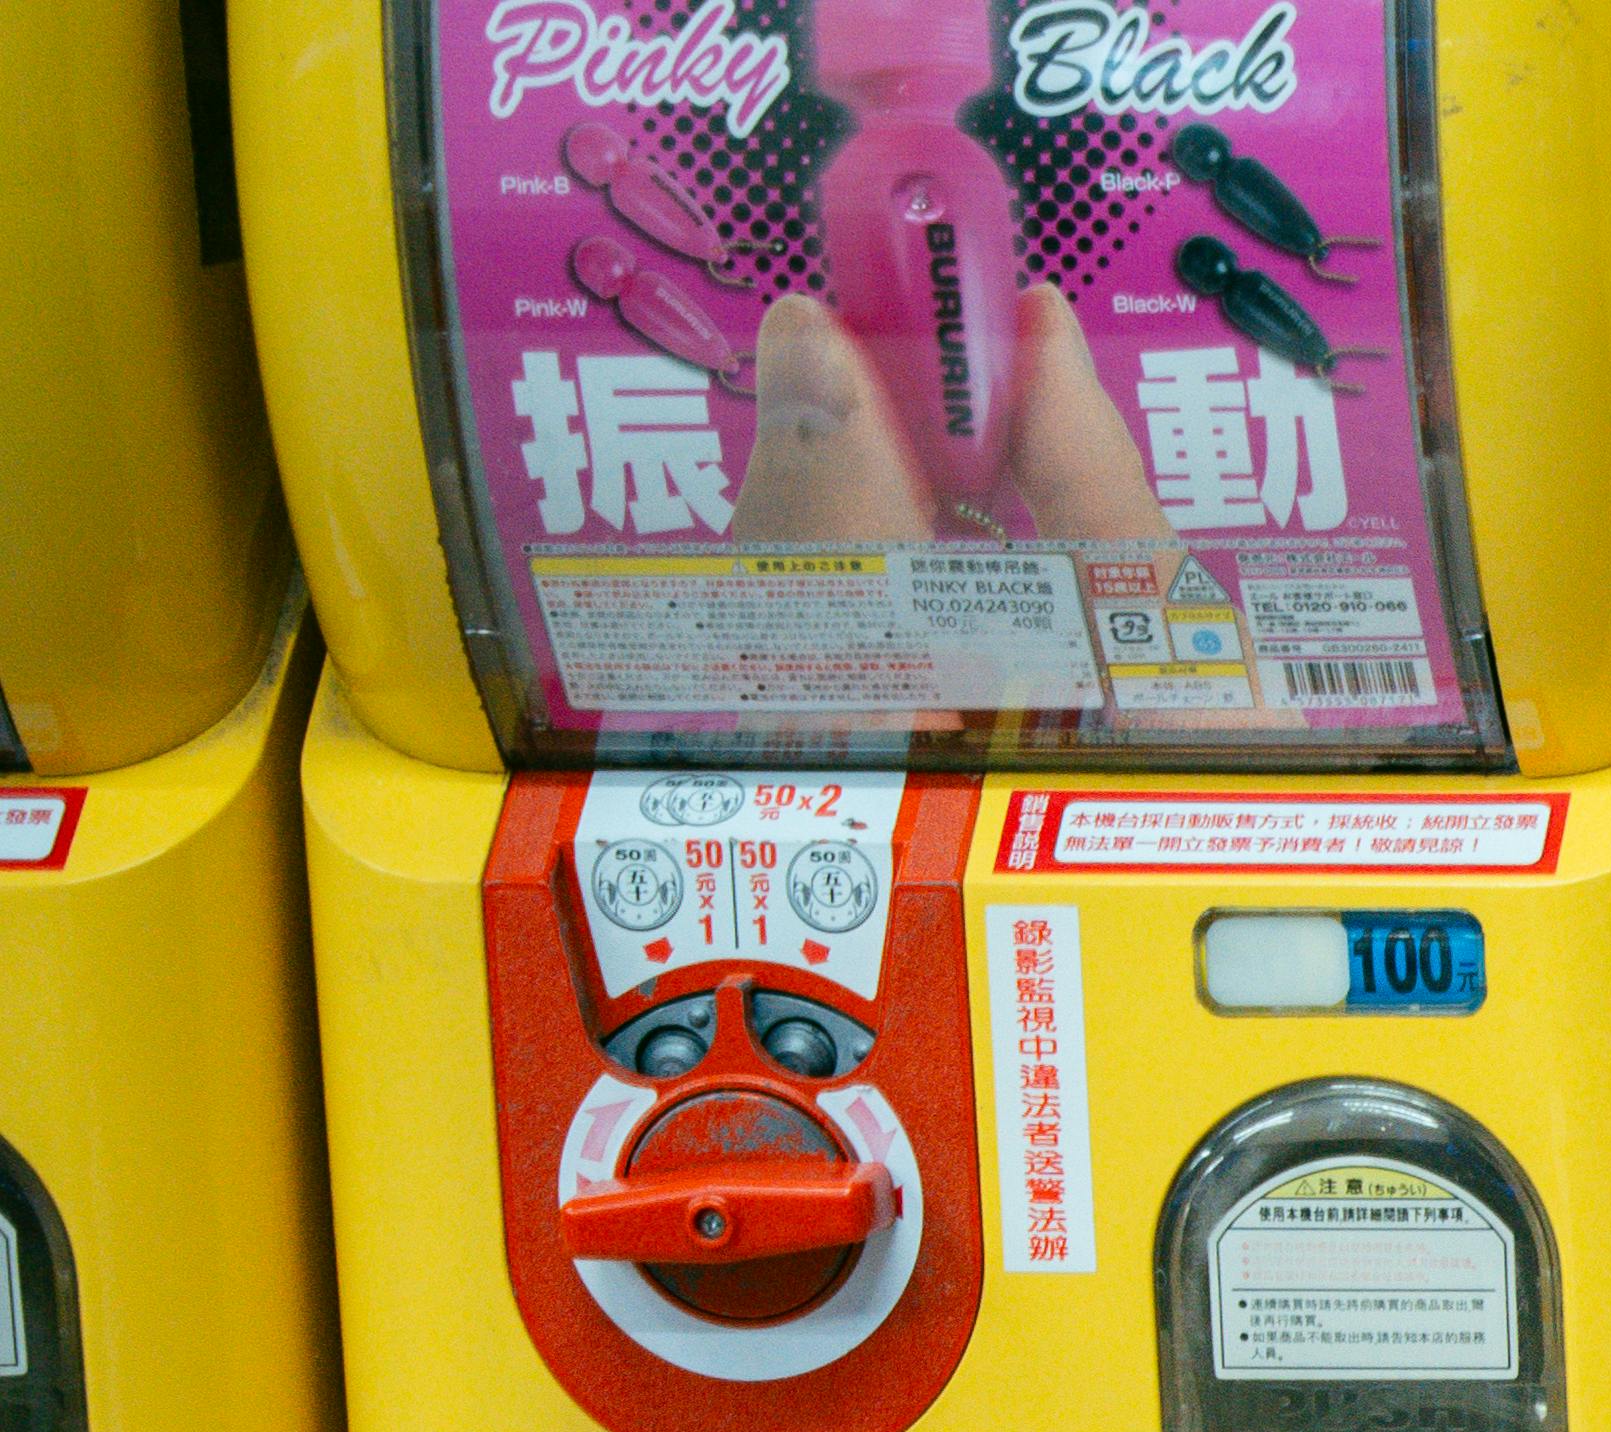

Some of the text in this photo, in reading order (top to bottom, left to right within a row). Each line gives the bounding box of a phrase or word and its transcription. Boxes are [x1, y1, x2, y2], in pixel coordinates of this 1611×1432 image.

[486, 0, 1297, 136] Pinky Black
[500, 174, 570, 197] Pink-B
[1101, 170, 1180, 193] Black-P
[515, 297, 588, 317] Pink-W
[1113, 293, 1197, 314] Black-W
[927, 222, 975, 439] BURURIN
[912, 579, 972, 597] PINKY
